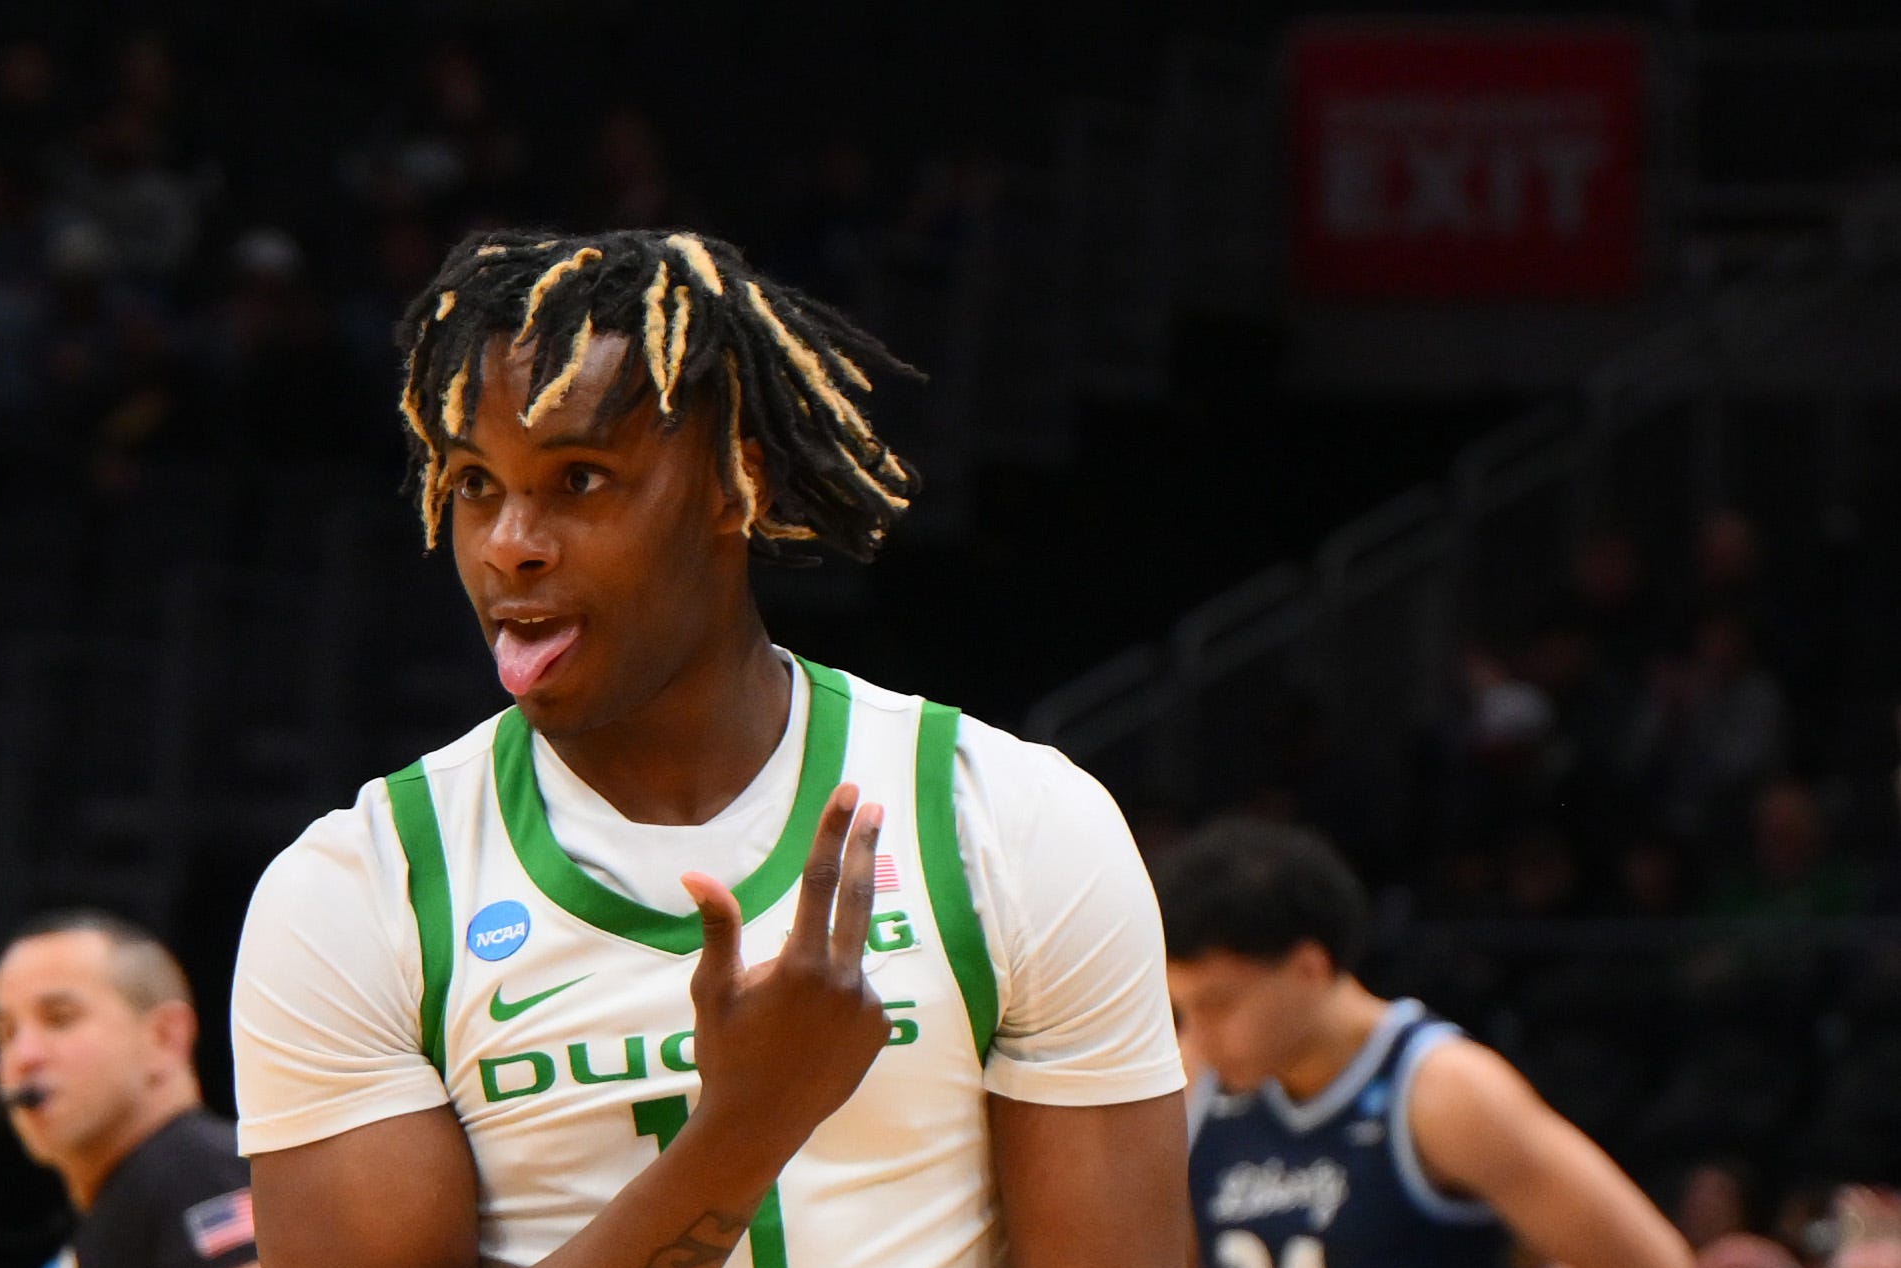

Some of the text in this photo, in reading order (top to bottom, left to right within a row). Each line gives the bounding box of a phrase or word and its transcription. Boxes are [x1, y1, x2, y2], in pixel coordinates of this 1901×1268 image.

[1320, 136, 1605, 236] EXIT
[475, 921, 526, 948] NCAA
[478, 1000, 920, 1103] DUCS
